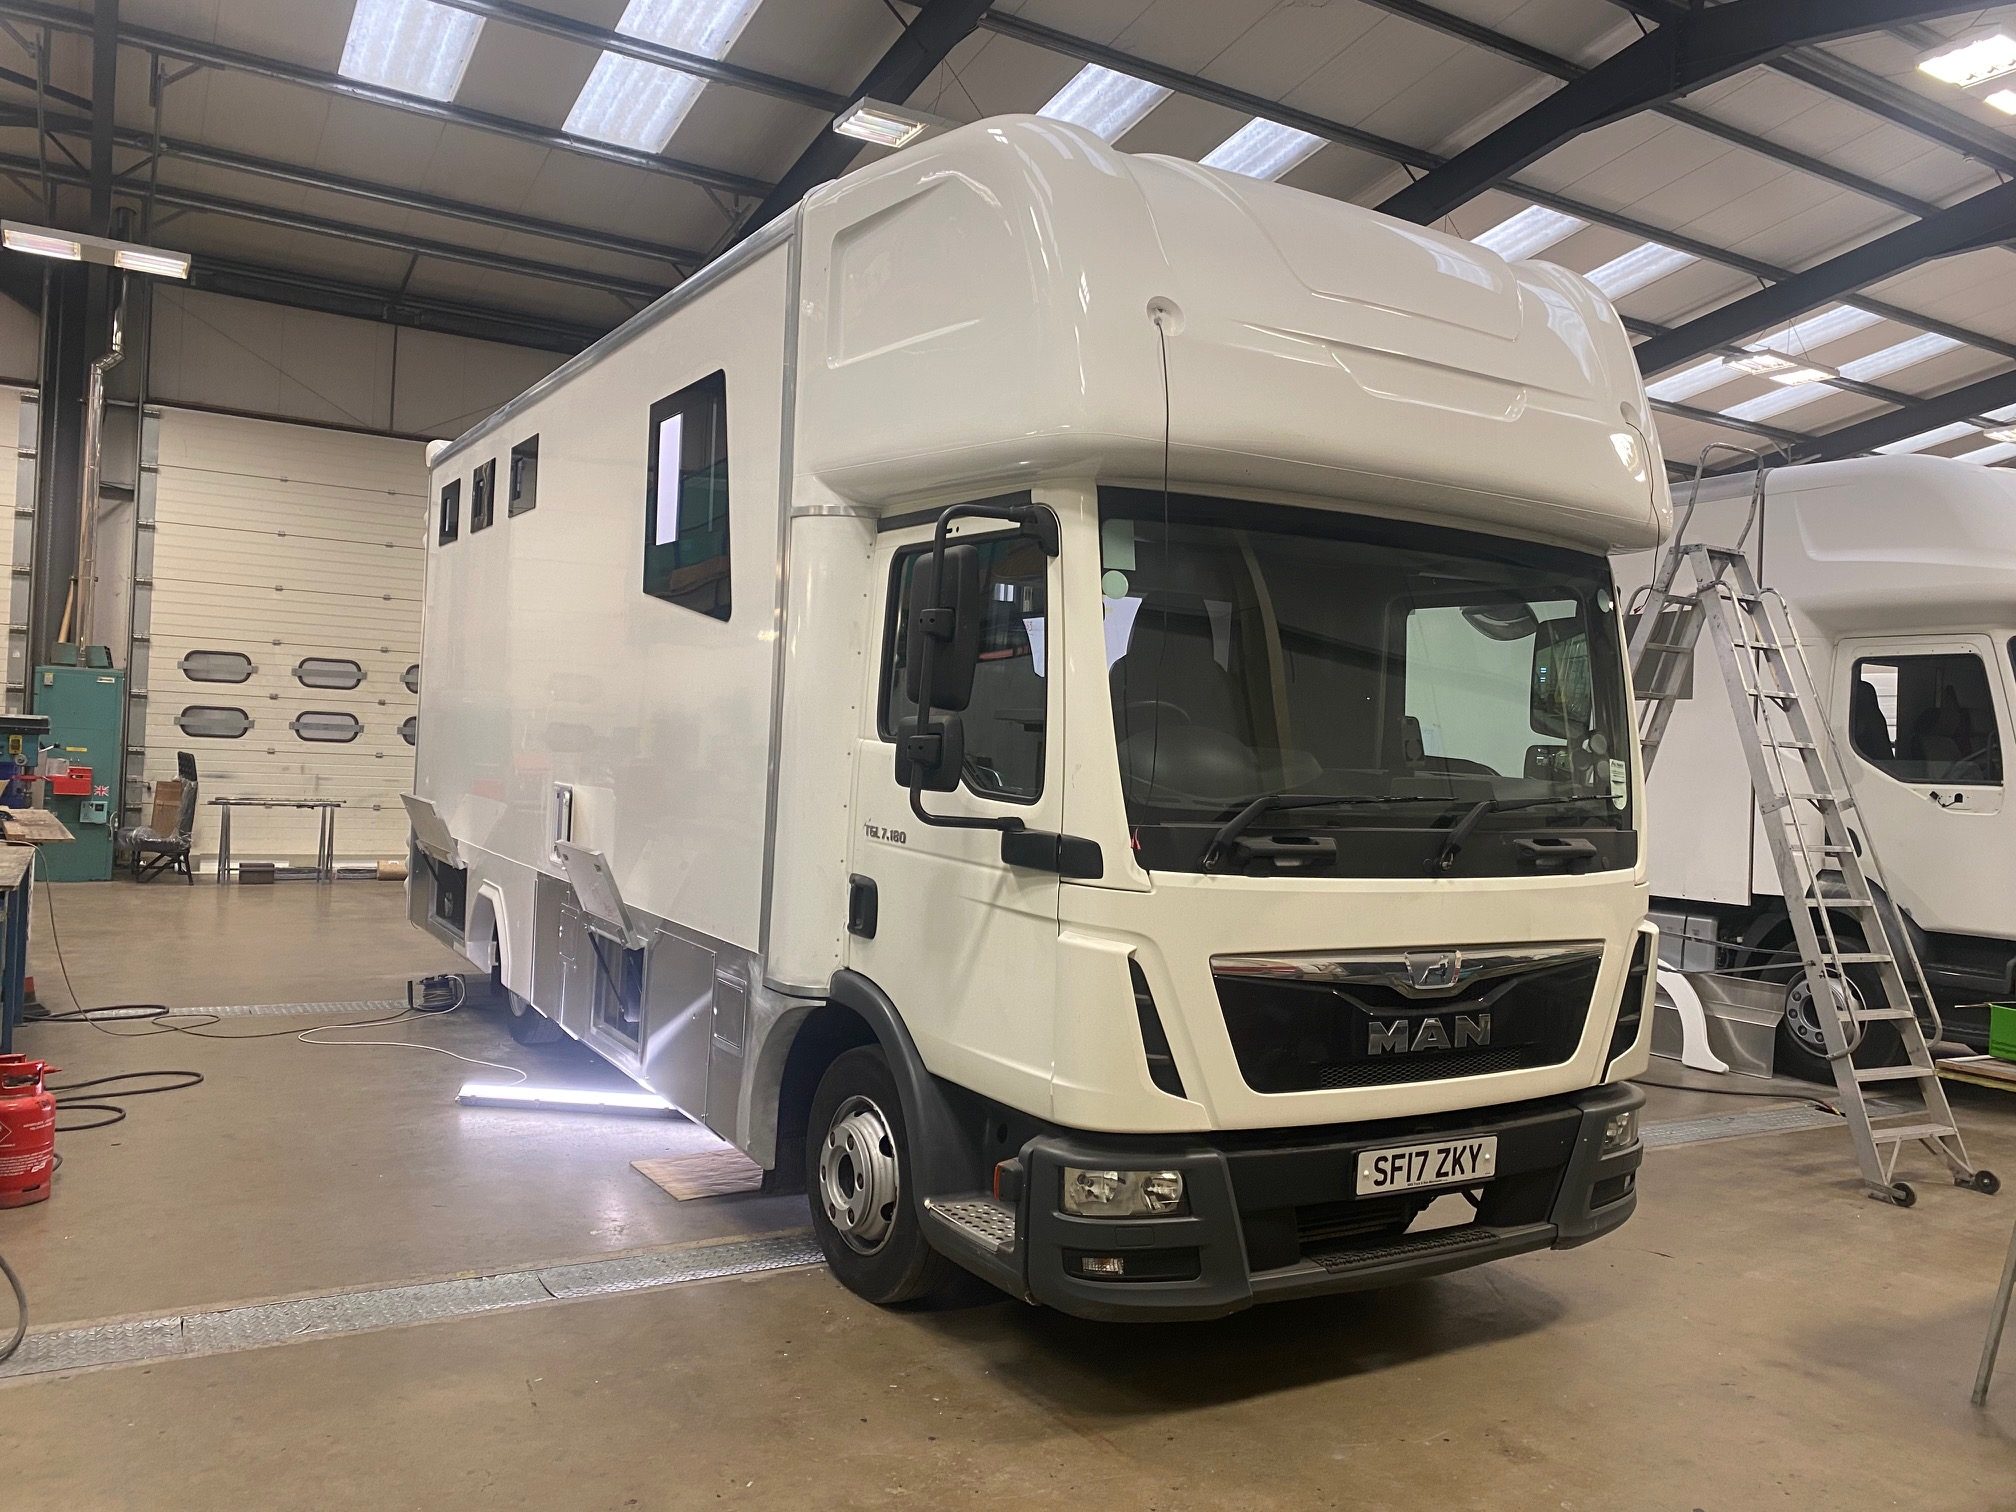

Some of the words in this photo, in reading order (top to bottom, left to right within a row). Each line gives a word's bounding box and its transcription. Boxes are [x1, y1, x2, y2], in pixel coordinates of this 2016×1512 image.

[864, 824, 880, 839] TGL
[881, 827, 906, 844] 7.180
[1368, 1013, 1490, 1055] MAN
[1373, 1150, 1430, 1187] SF17
[1435, 1143, 1483, 1179] ZKY
